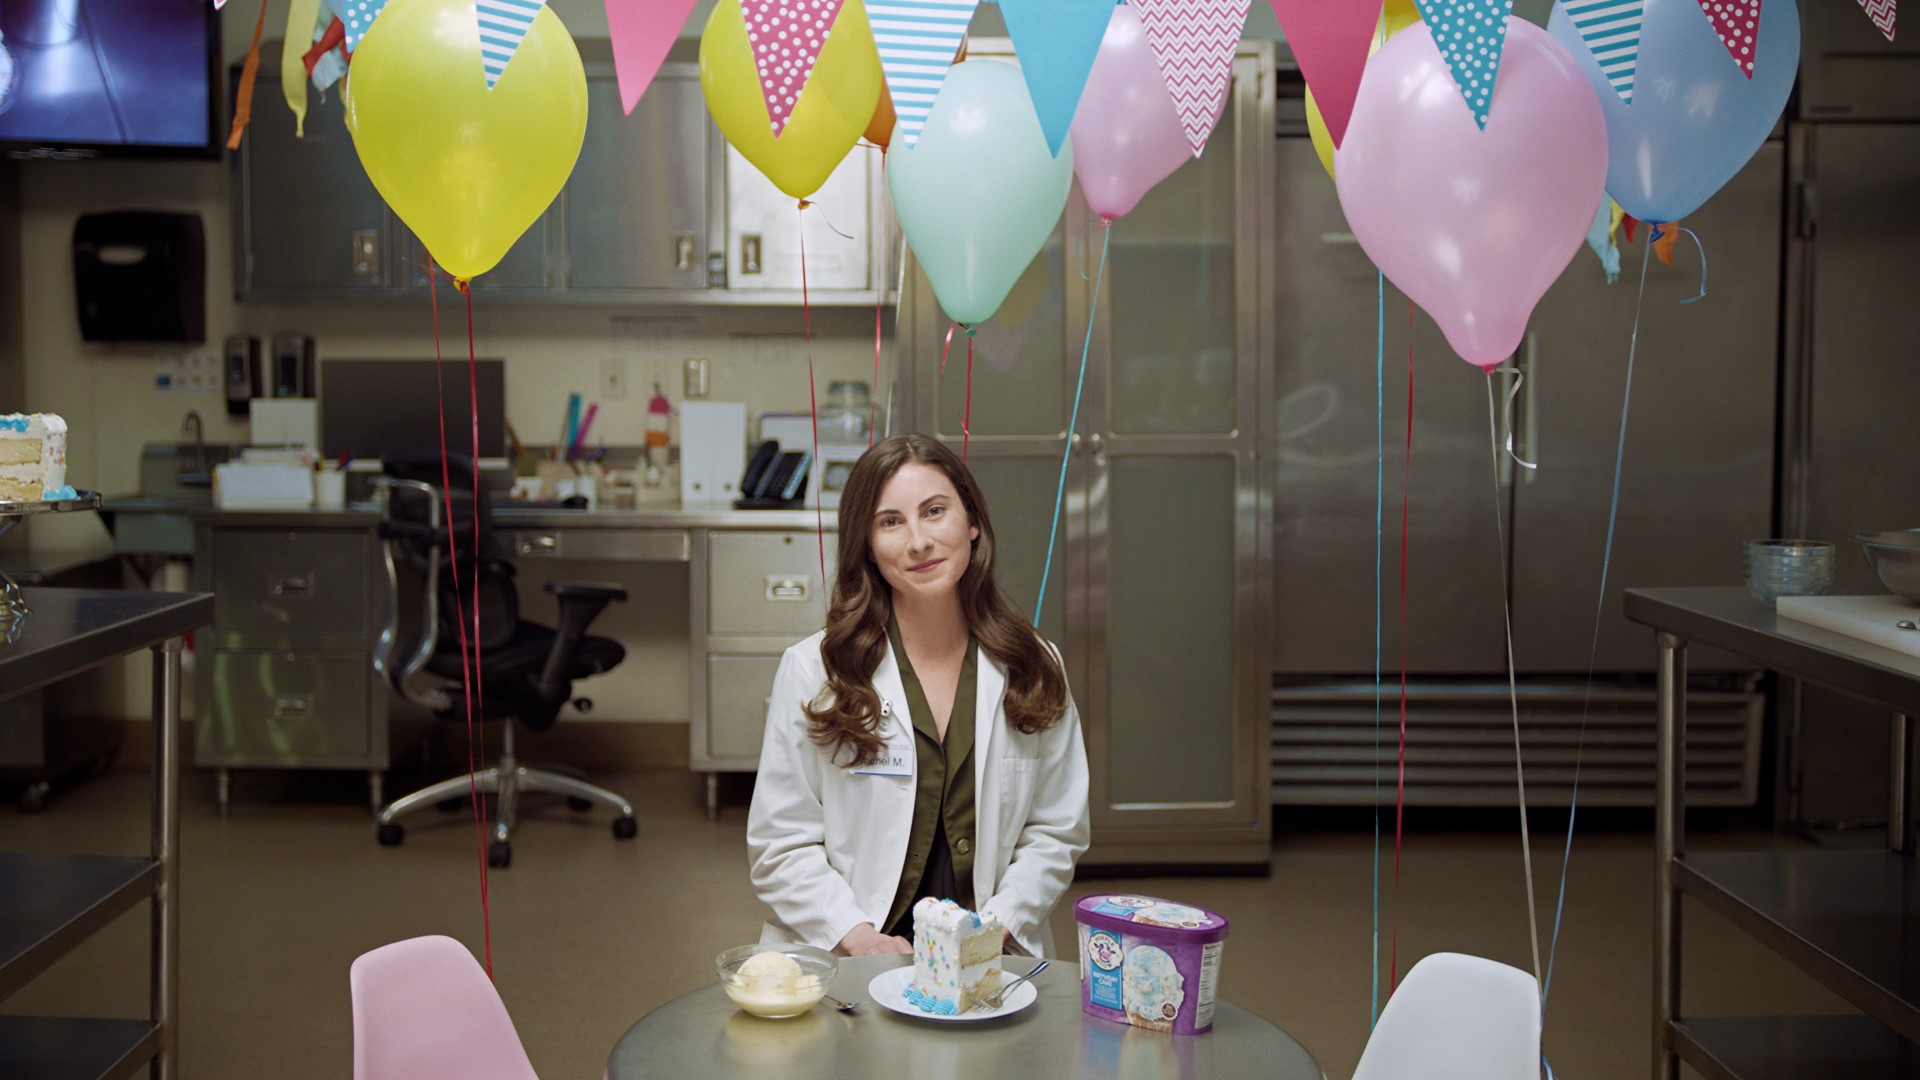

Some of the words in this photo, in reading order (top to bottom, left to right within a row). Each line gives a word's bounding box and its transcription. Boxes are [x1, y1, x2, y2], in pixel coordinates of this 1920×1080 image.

[893, 758, 905, 767] M.
[1093, 971, 1118, 983] BIRTHDAY
[1098, 978, 1113, 987] CAKE
